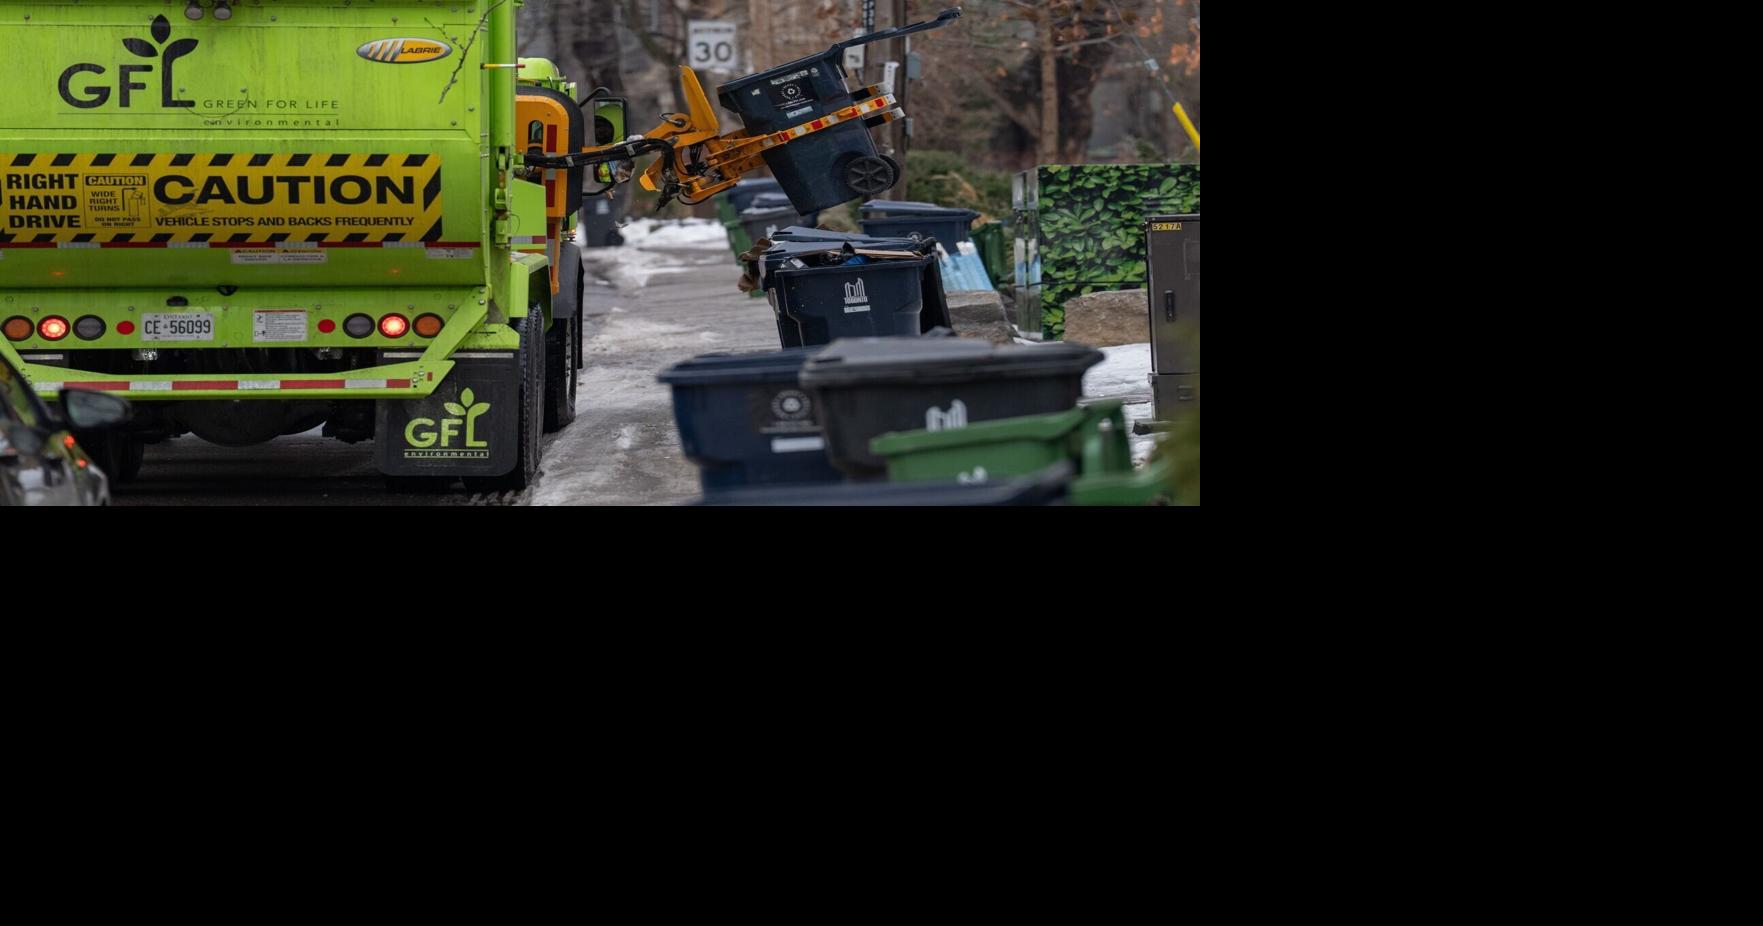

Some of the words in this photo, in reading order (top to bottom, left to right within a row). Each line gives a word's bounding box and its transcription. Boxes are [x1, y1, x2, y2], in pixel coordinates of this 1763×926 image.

[695, 41, 731, 62] 30
[58, 38, 199, 109] GFL
[203, 99, 257, 109] GREEN
[266, 99, 297, 109] FOR
[306, 99, 339, 109] LIFE
[6, 173, 79, 190] RIGHT
[88, 176, 144, 185] CAUTION
[153, 174, 415, 205] CAUTION
[9, 195, 77, 210] HAND
[9, 215, 81, 228] DRIVE
[156, 217, 209, 226] VEHICLE
[212, 217, 255, 226] STOPS
[257, 217, 285, 226] AND
[289, 217, 332, 226] BACKS
[335, 217, 414, 227] FREQUENTLY
[144, 320, 161, 334] CE
[169, 320, 211, 334] 56099
[404, 403, 491, 448] GFL
